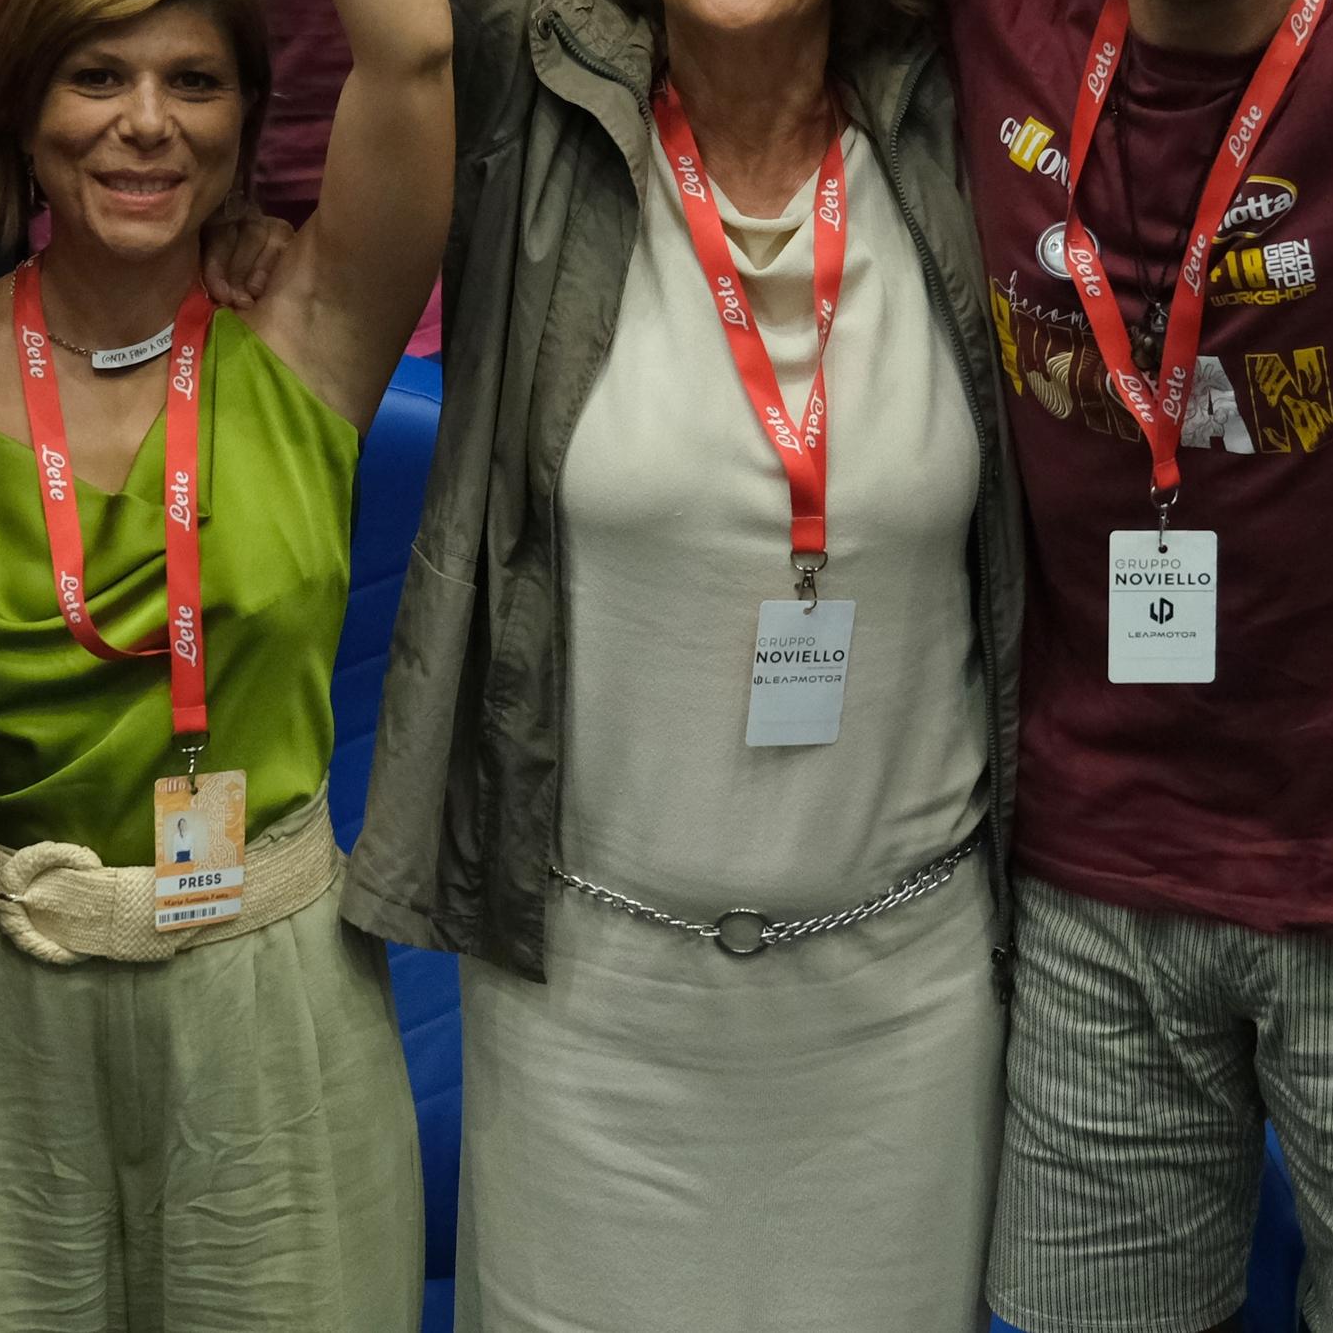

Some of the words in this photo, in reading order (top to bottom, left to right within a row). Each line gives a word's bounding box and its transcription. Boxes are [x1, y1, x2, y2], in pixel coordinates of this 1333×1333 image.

[1087, 42, 1116, 103] Lete
[999, 116, 1071, 195] GIffON
[1228, 104, 1263, 168] Lete
[678, 155, 707, 203] Lete
[818, 177, 842, 232] Lete
[1068, 242, 1102, 298] Lete
[1183, 233, 1207, 298] Lete
[1263, 238, 1311, 260] GEN
[1265, 254, 1314, 275] ERA
[718, 274, 749, 331] Lete
[1211, 283, 1317, 308] WORKSHOP
[1269, 269, 1316, 289] TOR
[21, 325, 48, 379] Lete
[129, 347, 148, 360] FINO
[150, 342, 156, 352] A
[173, 344, 196, 401] Lete
[805, 389, 824, 449] Lete
[1116, 369, 1155, 424] Lete
[1162, 365, 1187, 425] Lete
[766, 405, 804, 455] Lete
[41, 444, 68, 502] Lete
[169, 470, 191, 532] Lete
[1114, 558, 1182, 570] GRUPPO
[1115, 572, 1211, 586] NOVIELLO
[61, 570, 83, 625] Lete
[174, 604, 197, 668] Lete
[756, 649, 845, 664] NOVIELLO
[757, 636, 816, 647] GRUPPO
[1127, 631, 1197, 639] LEAPMOTOR
[764, 674, 843, 685] LEAPMOTOR
[178, 872, 223, 891] PRESS
